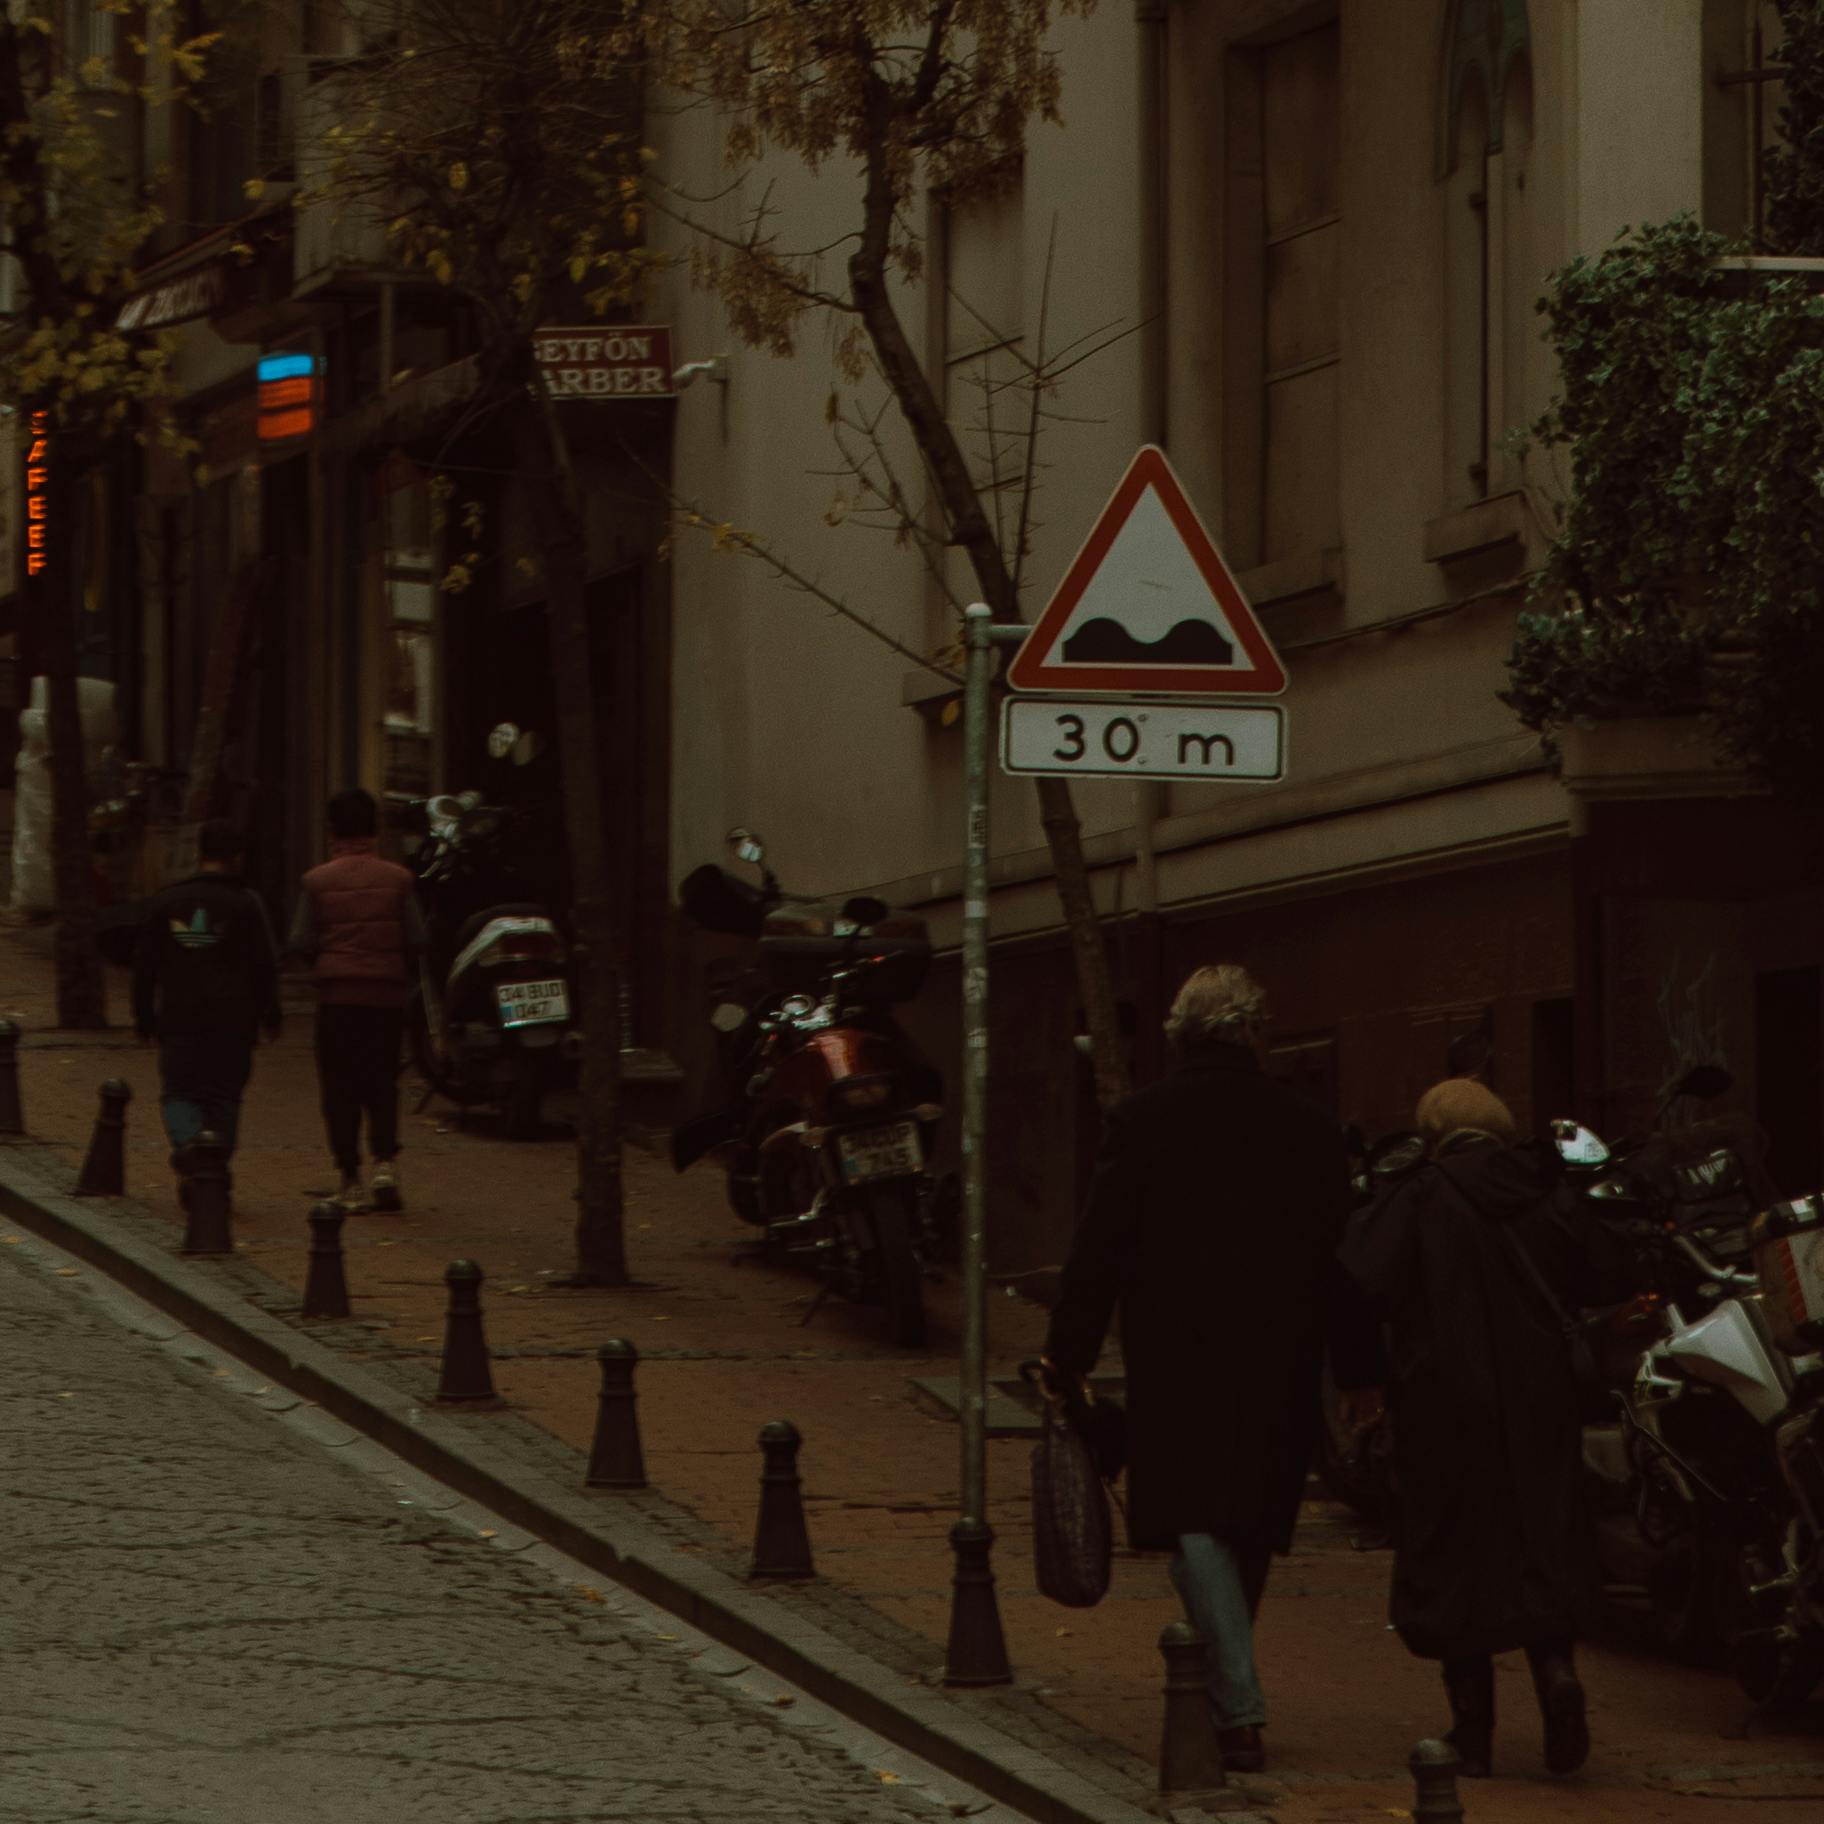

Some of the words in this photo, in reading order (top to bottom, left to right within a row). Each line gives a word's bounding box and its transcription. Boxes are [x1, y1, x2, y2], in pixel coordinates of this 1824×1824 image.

[526, 366, 668, 399] ARBER
[1052, 714, 1139, 762] 30
[1178, 732, 1234, 765] m
